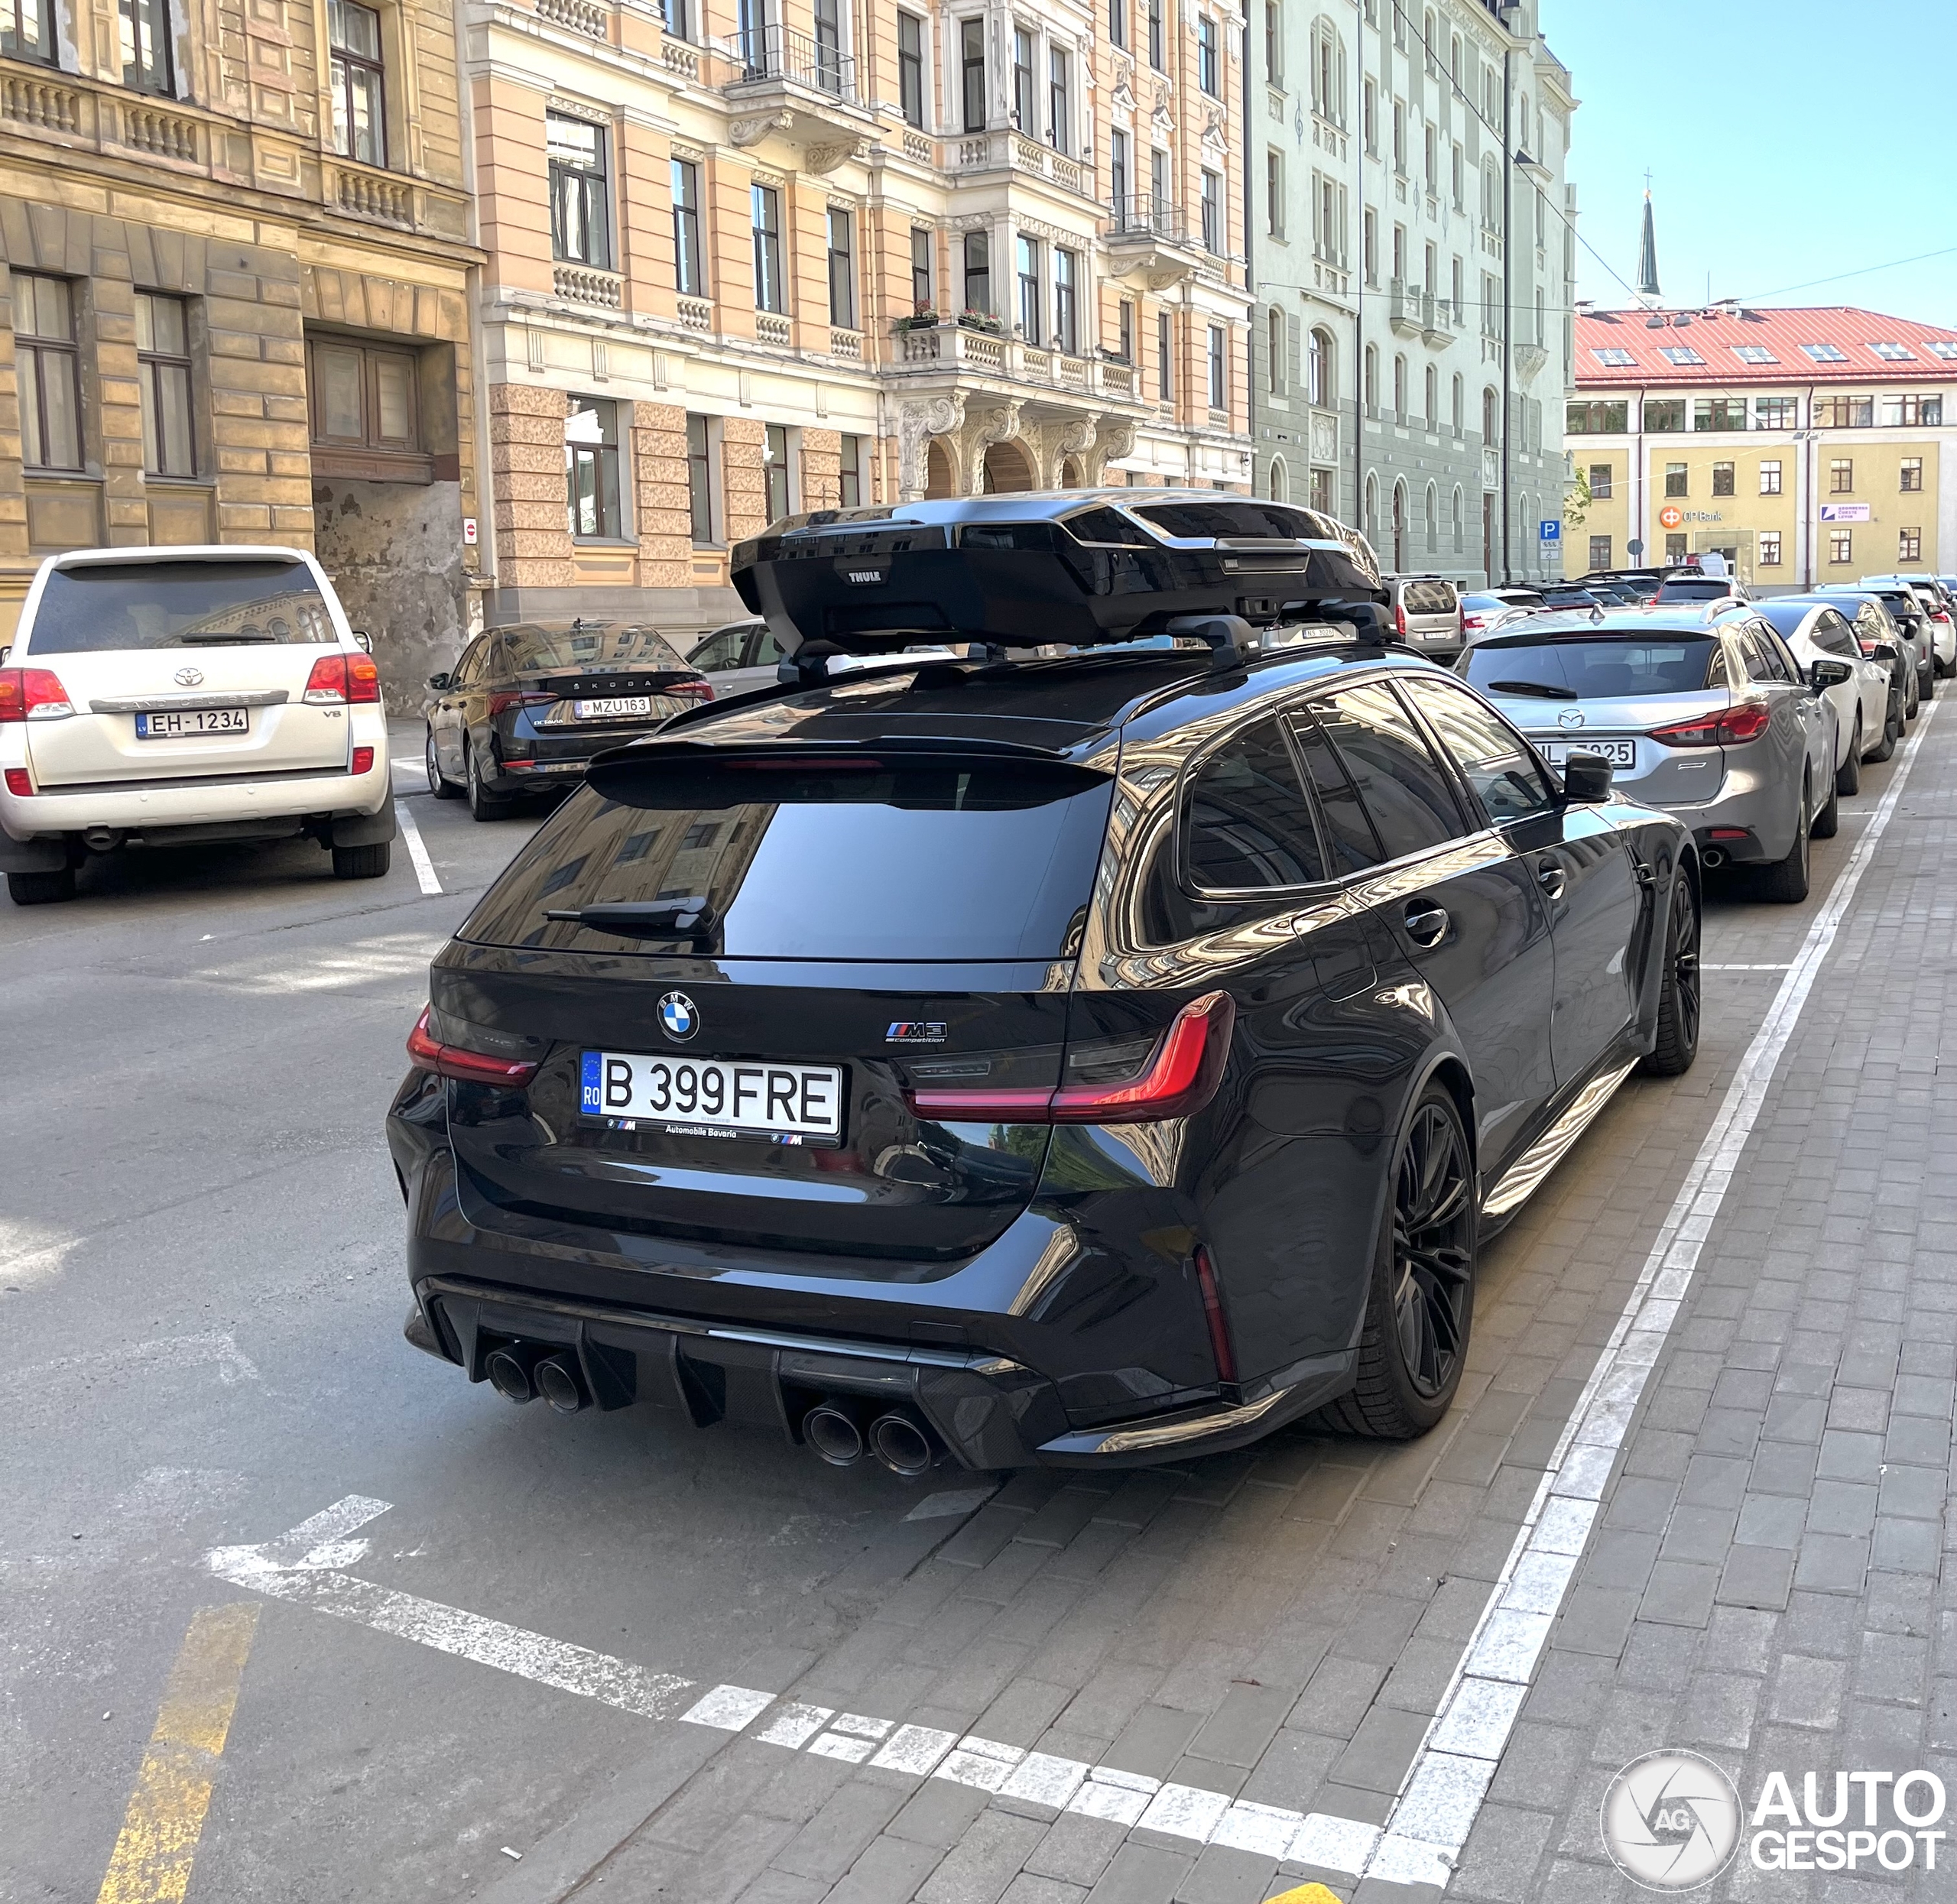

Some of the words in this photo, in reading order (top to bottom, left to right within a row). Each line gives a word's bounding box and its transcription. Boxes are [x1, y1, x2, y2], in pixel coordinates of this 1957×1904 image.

[1683, 511, 1697, 522] OP
[1699, 510, 1722, 522] Bank
[1544, 522, 1556, 537] P
[849, 571, 881, 582] THULE
[118, 699, 166, 709] LAND
[180, 694, 262, 707] CRUISER
[592, 699, 646, 713] MZU163
[660, 994, 693, 1010] BMW
[905, 1023, 947, 1037] M3
[605, 1059, 633, 1108] B
[583, 1086, 600, 1106] RO
[666, 1124, 706, 1136] Automobile
[708, 1127, 737, 1138] Bavaria
